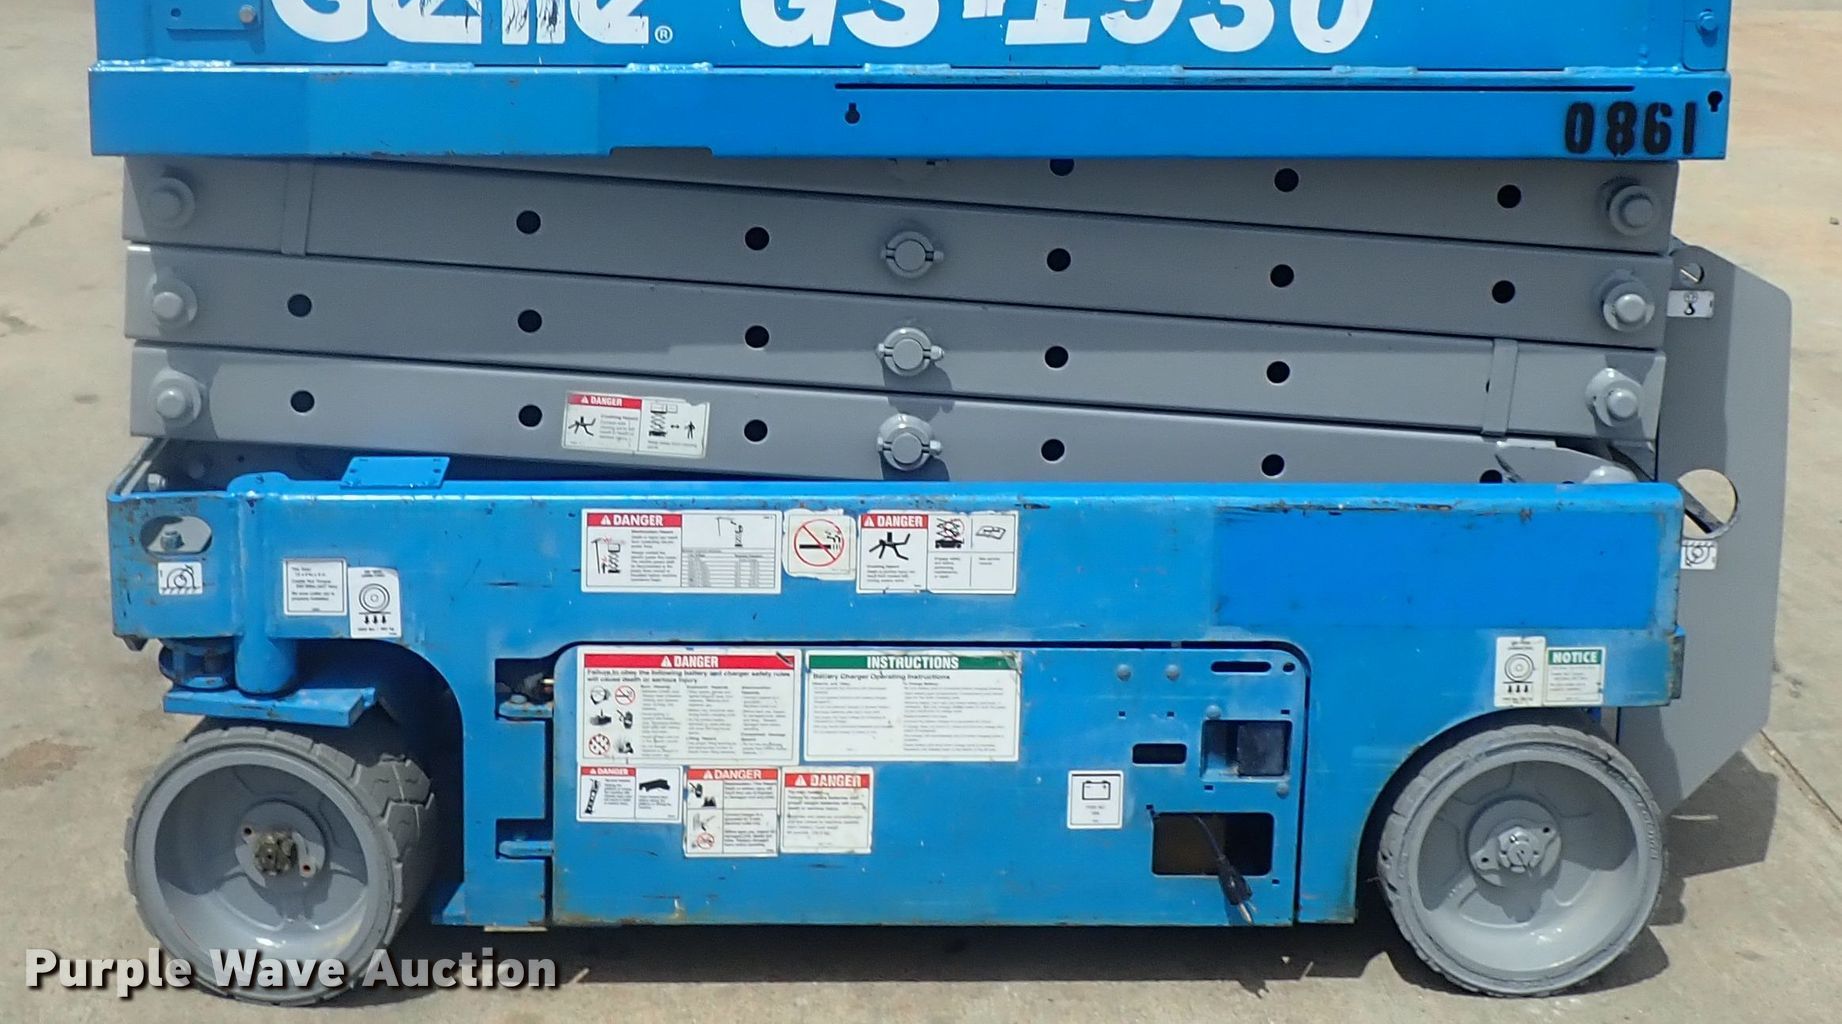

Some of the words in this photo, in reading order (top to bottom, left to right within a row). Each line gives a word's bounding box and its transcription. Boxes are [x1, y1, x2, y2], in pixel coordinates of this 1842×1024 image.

[590, 396, 623, 407] DANGER
[613, 514, 664, 527] DANGER
[877, 515, 924, 528] DANGER
[673, 655, 720, 668] DANGER
[866, 656, 960, 670] INSTRUCTIONS
[1552, 650, 1598, 664] NOTICE
[597, 767, 629, 776] DANGER
[714, 768, 762, 780] DANGER
[810, 774, 862, 787] DANGER
